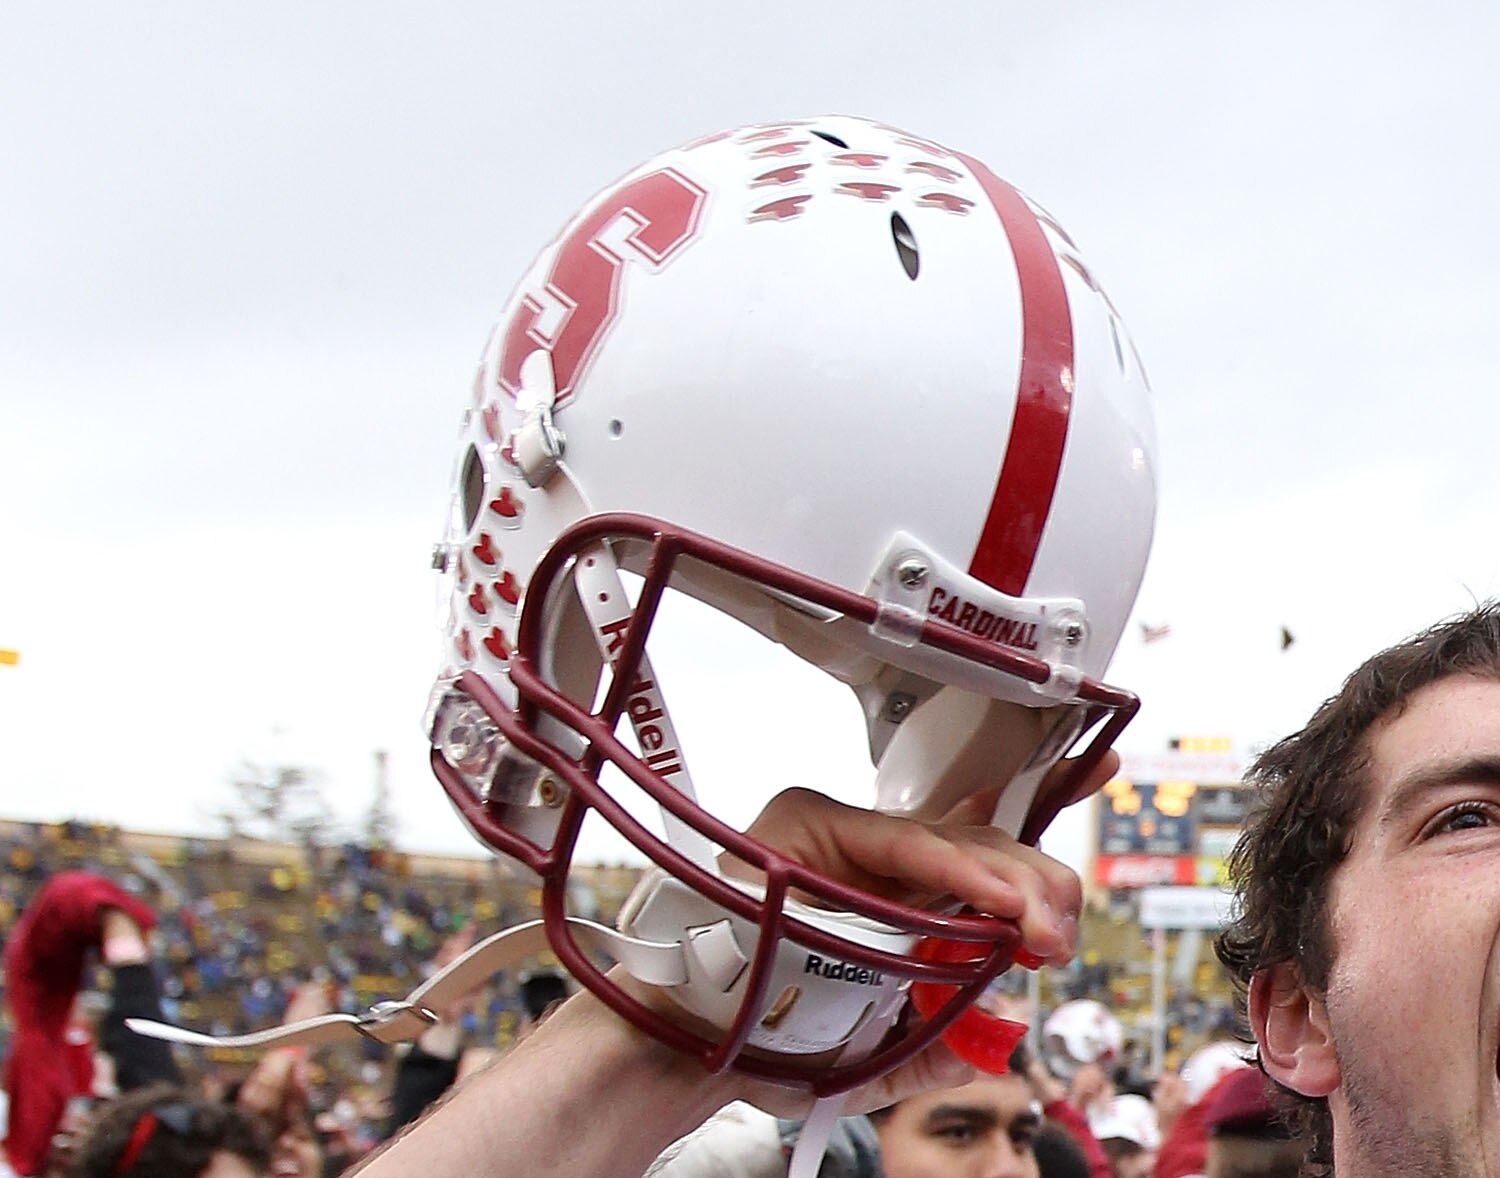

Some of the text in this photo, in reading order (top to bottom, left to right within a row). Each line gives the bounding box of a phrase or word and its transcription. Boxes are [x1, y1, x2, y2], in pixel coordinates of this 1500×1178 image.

[928, 586, 1038, 650] CARDINAL
[601, 617, 682, 777] Rdell
[804, 954, 883, 986] Riddell
